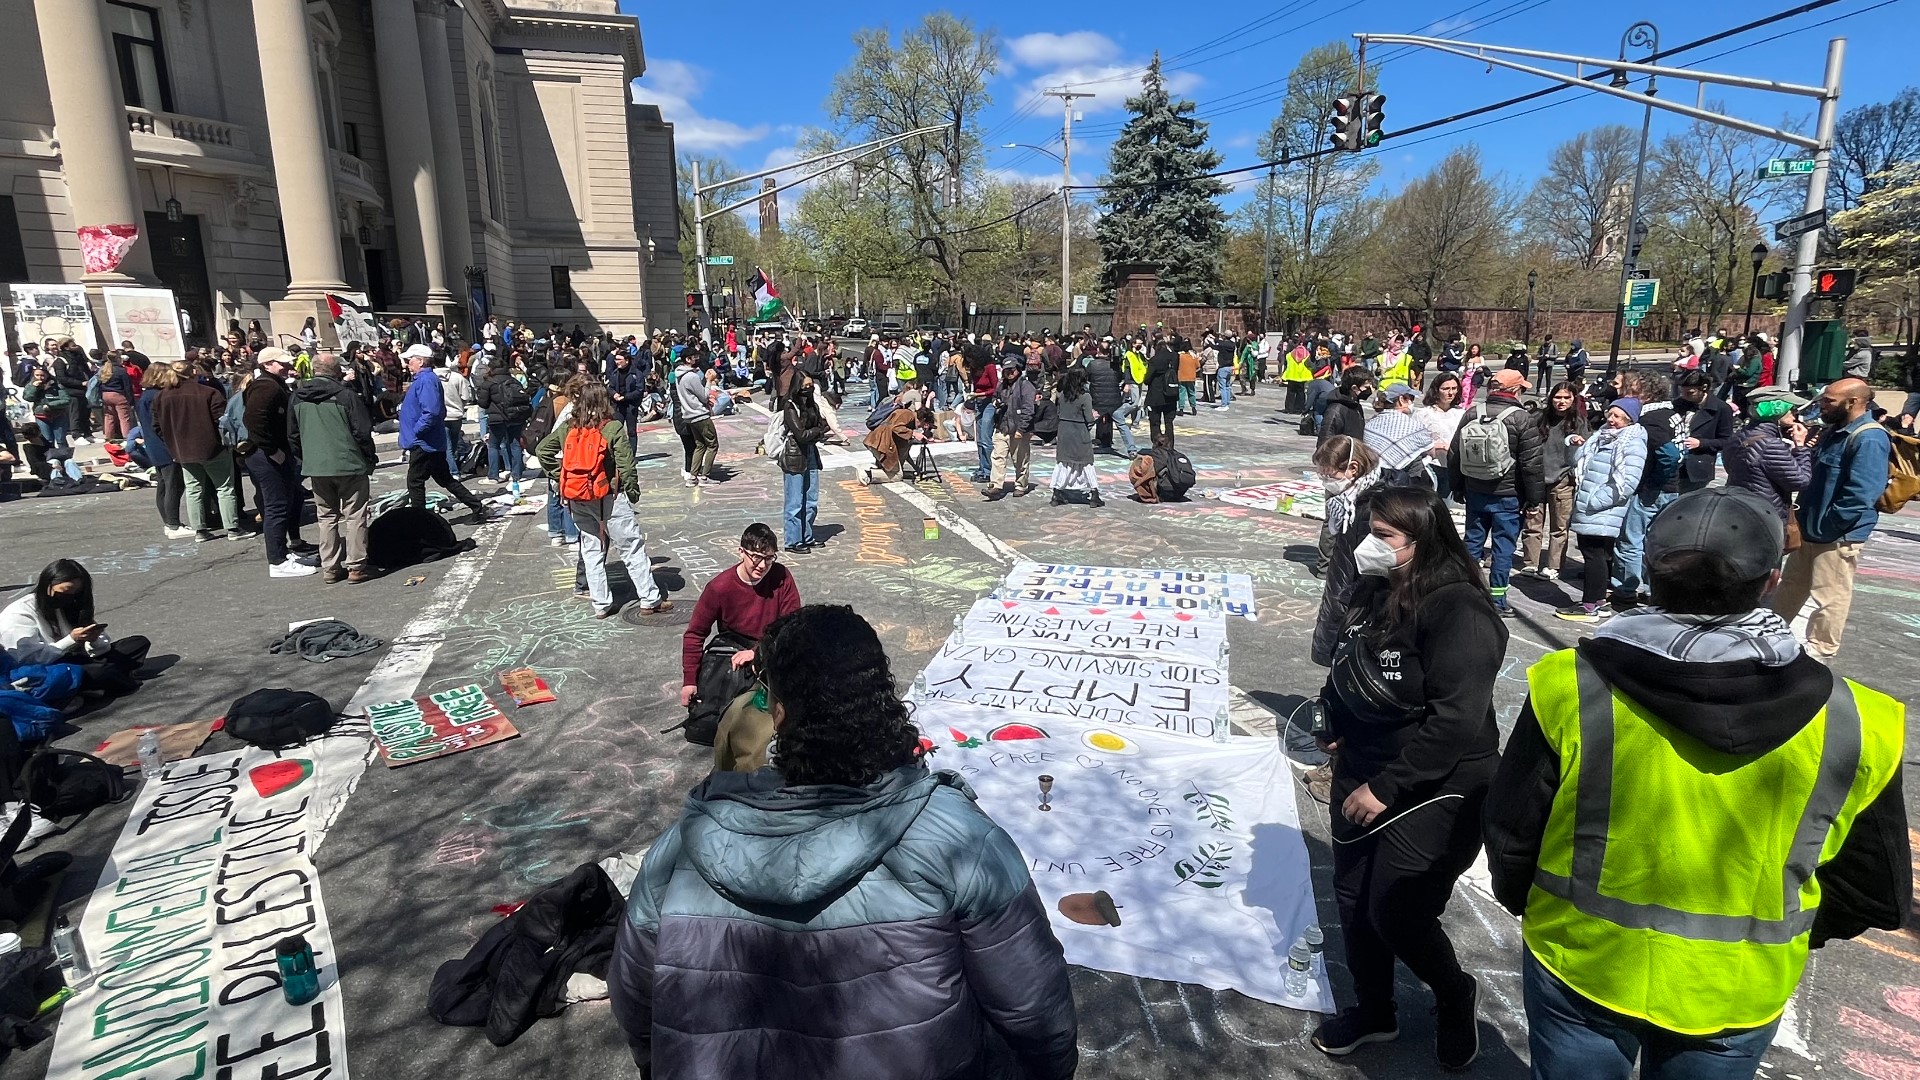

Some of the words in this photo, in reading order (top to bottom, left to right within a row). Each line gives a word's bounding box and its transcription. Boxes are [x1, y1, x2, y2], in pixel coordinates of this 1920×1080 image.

[1772, 161, 1806, 171] PROPECT
[1783, 222, 1800, 234] ONE
[1804, 216, 1818, 227] WAY
[1023, 575, 1113, 591] FREE
[1033, 564, 1228, 584] PALESTINE
[1125, 580, 1147, 592] A
[1161, 582, 1229, 598] FOR
[1080, 590, 1249, 614] ANOTHER
[979, 610, 1112, 632] PALESTINE
[1129, 622, 1199, 639] FREE
[1005, 626, 1025, 638] A
[1090, 634, 1175, 650] JEWS
[943, 640, 1017, 663] GAZA
[1031, 651, 1155, 677] STARVING
[1161, 665, 1221, 685] STOP
[1382, 671, 1402, 680] NTS
[925, 689, 956, 699] AR
[931, 663, 1192, 712] EMPTY
[428, 683, 501, 727] FREE
[968, 692, 1052, 715] PLATES
[1068, 701, 1140, 725] SEDER
[364, 698, 447, 760] PALESTINE
[1153, 712, 1215, 738] OUR
[988, 751, 1057, 768] FREE
[1111, 769, 1142, 786] NO
[136, 757, 244, 836] ISSUE
[1138, 788, 1171, 816] ONE
[1150, 824, 1174, 839] IS
[1094, 839, 1167, 873] FREE
[1030, 858, 1086, 875] UNT
[212, 795, 324, 1006] PALESTINE
